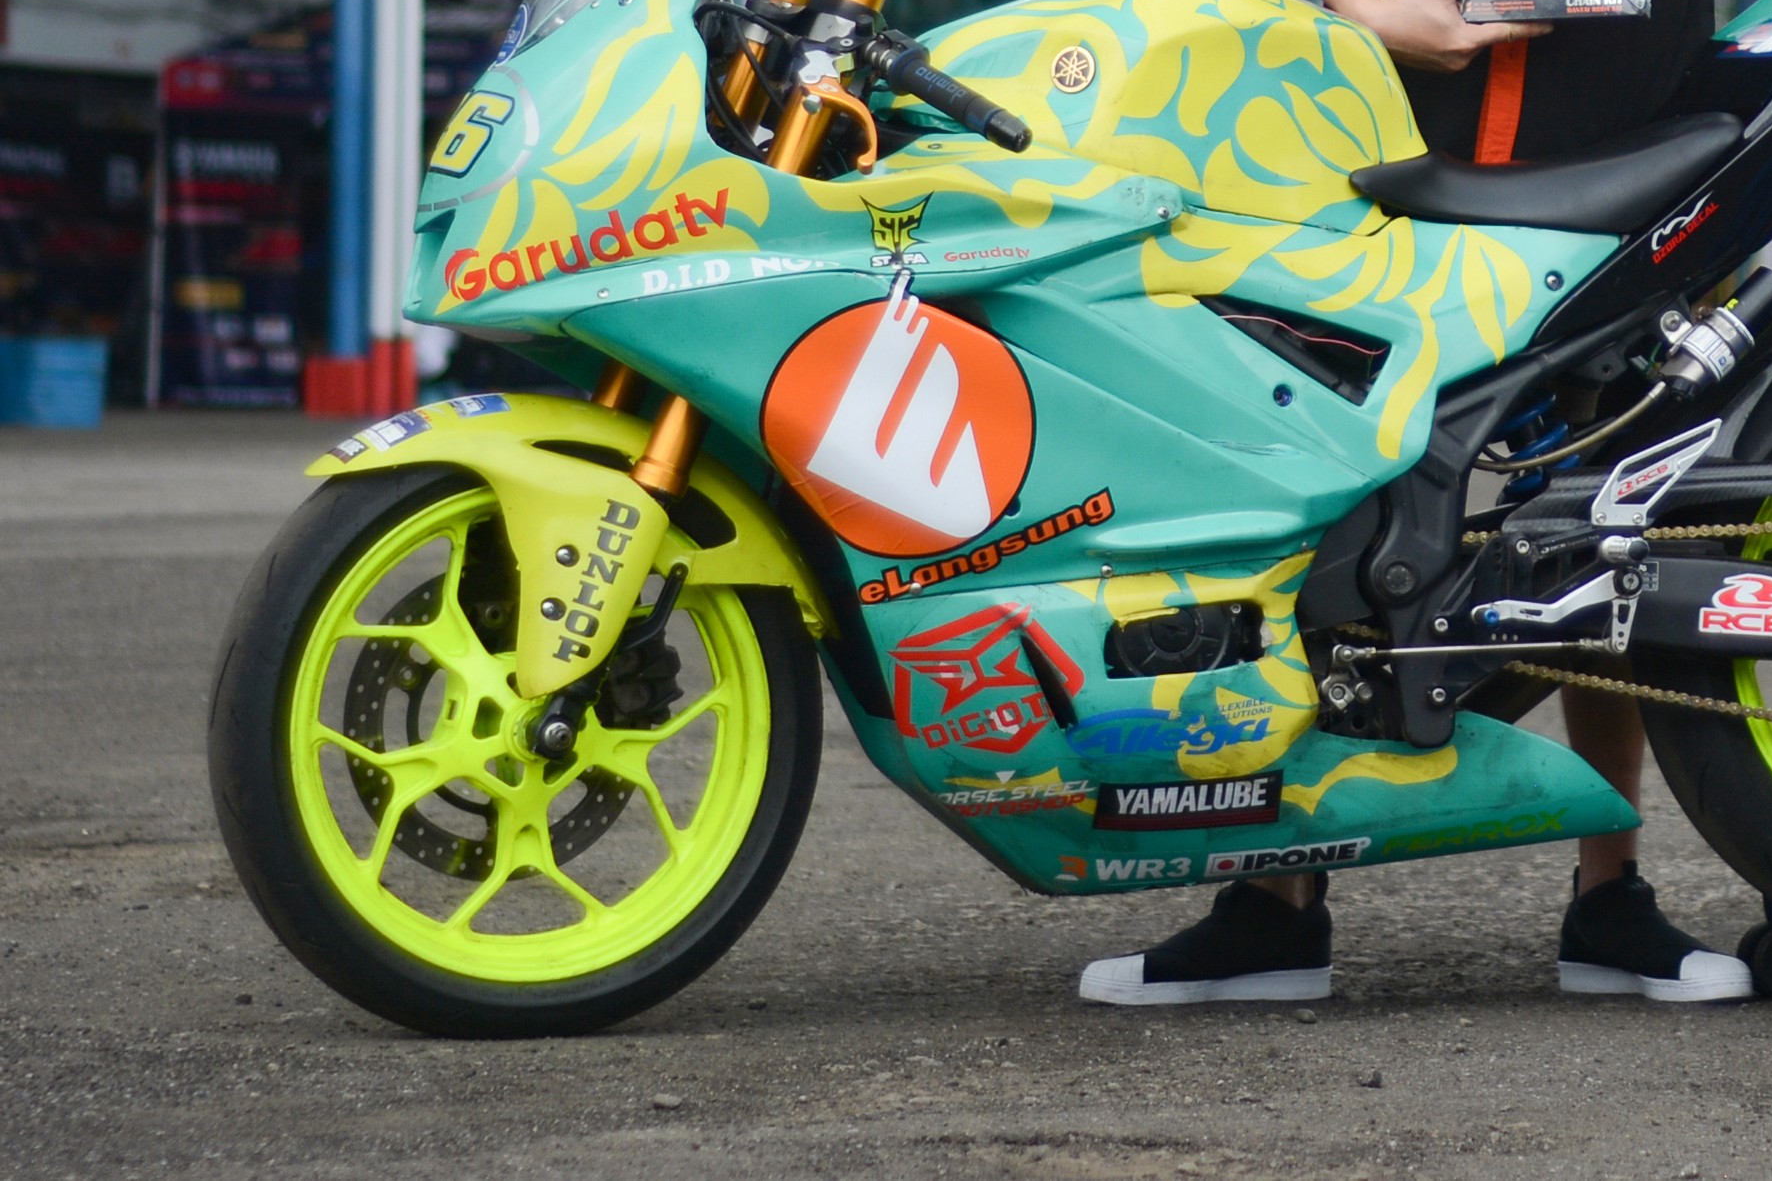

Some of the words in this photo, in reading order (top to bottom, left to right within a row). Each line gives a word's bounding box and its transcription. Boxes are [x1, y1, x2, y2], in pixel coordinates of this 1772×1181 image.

[444, 187, 730, 302] Garudatv
[944, 246, 1030, 262] Garudatv
[641, 258, 732, 296] D.I.D
[1635, 464, 1668, 486] RCB
[858, 487, 1116, 605] eLangsung
[553, 499, 641, 663] DUNLOP
[1010, 780, 1097, 801] STEEL
[1116, 776, 1270, 815] YAMALUBE
[1095, 856, 1192, 882] WR3
[1241, 841, 1358, 871] IPONE
